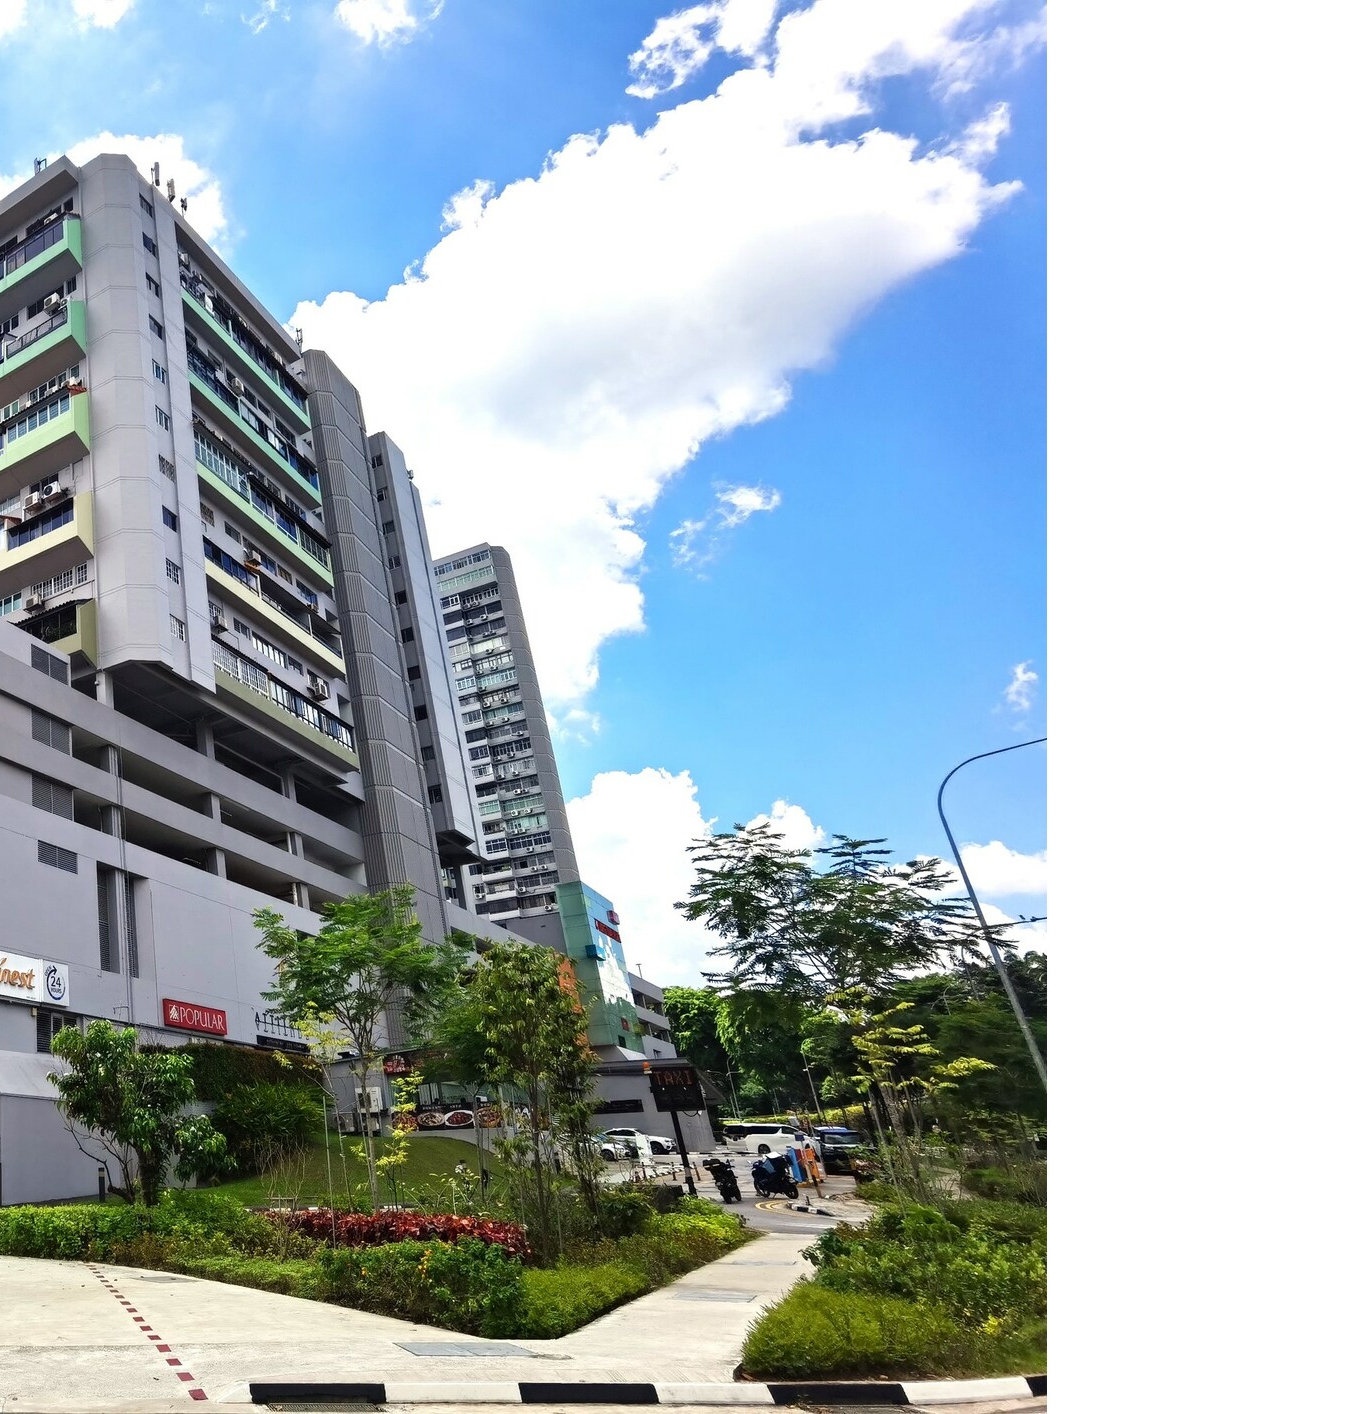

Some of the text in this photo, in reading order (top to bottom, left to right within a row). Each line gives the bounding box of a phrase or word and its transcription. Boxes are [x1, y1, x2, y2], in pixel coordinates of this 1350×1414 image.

[50, 976, 62, 988] 24
[179, 1006, 225, 1031] POPULAR
[652, 1069, 693, 1086] TAXI
